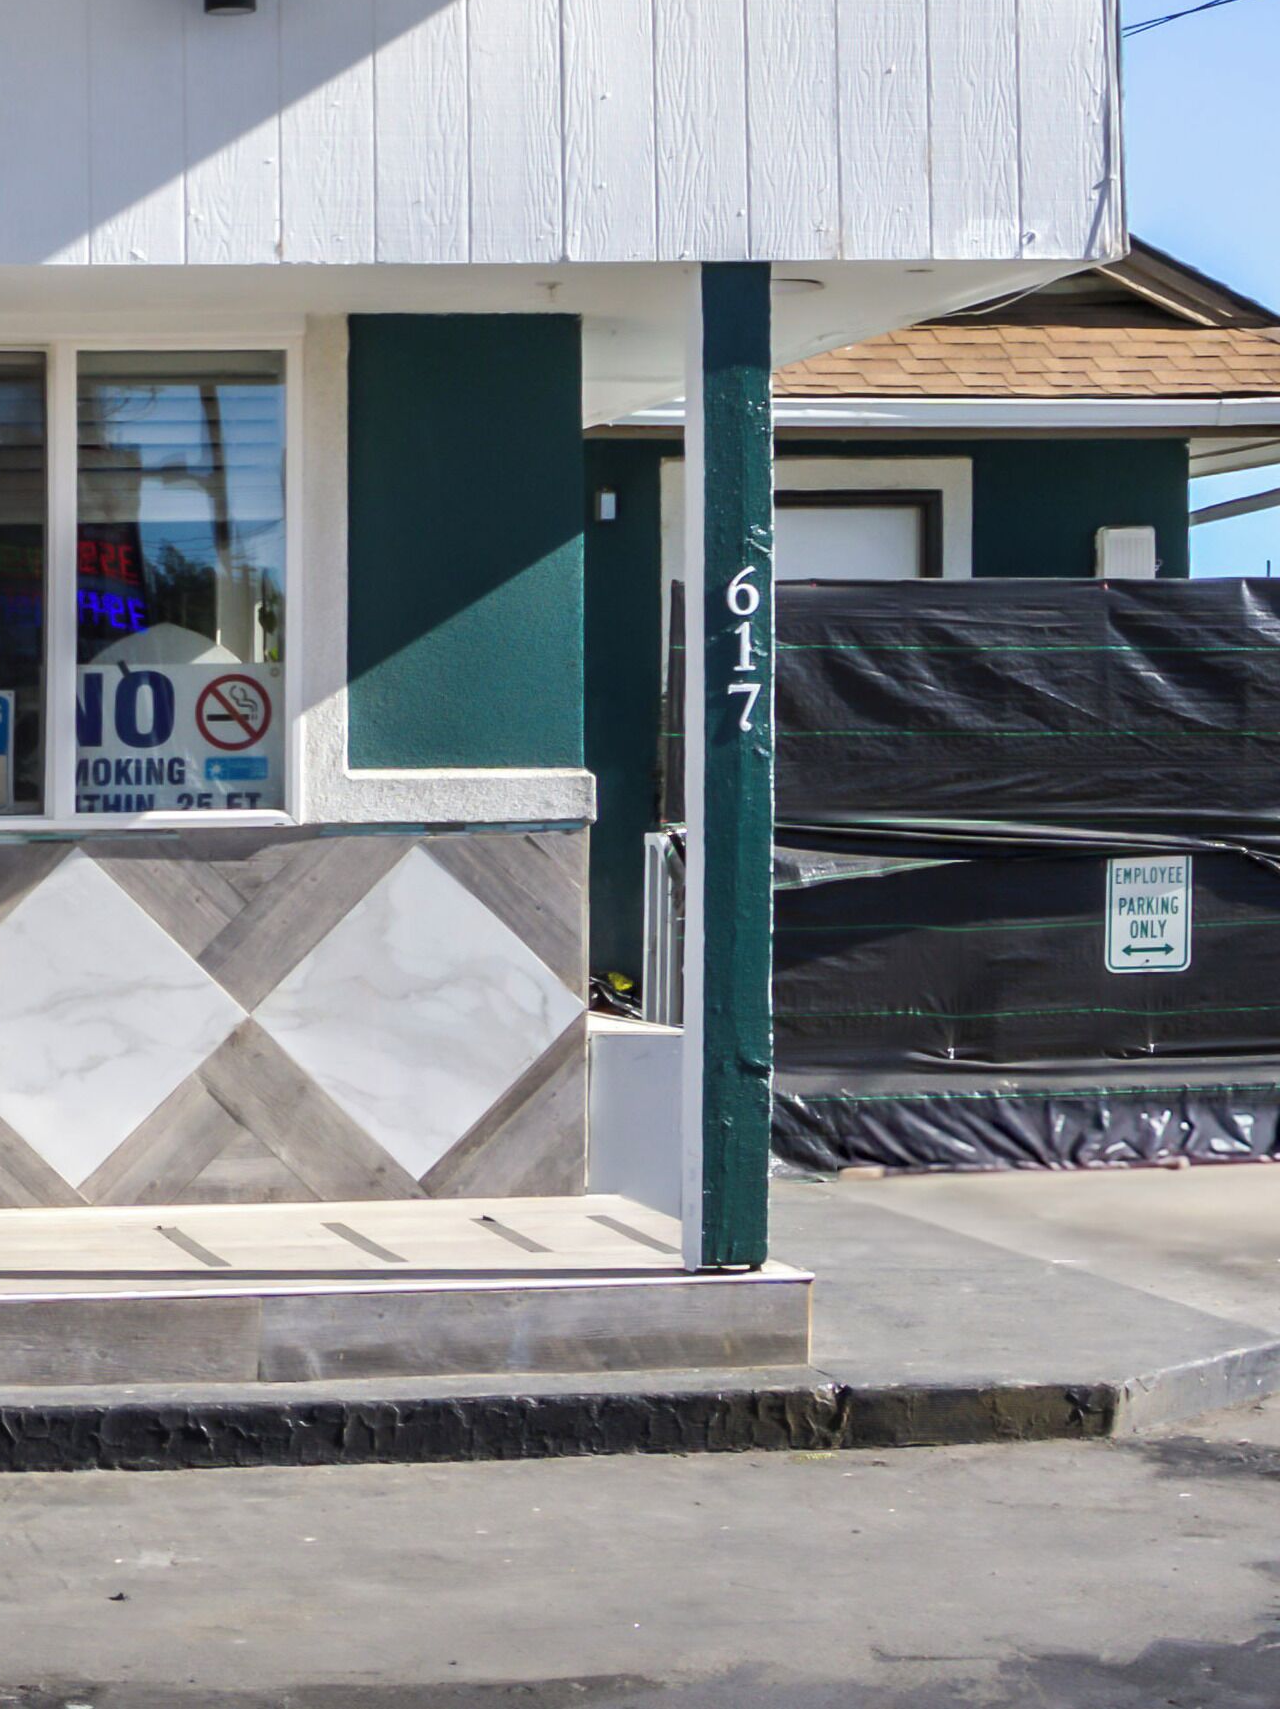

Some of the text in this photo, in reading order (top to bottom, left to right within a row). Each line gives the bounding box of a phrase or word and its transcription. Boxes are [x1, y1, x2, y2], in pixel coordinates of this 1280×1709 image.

[726, 565, 762, 732] 617
[76, 670, 175, 749] NO
[76, 757, 186, 787] MOKING
[1115, 866, 1184, 885] EMPLOYEE
[1118, 896, 1179, 916] PARKING
[1130, 919, 1167, 939] ONLY
